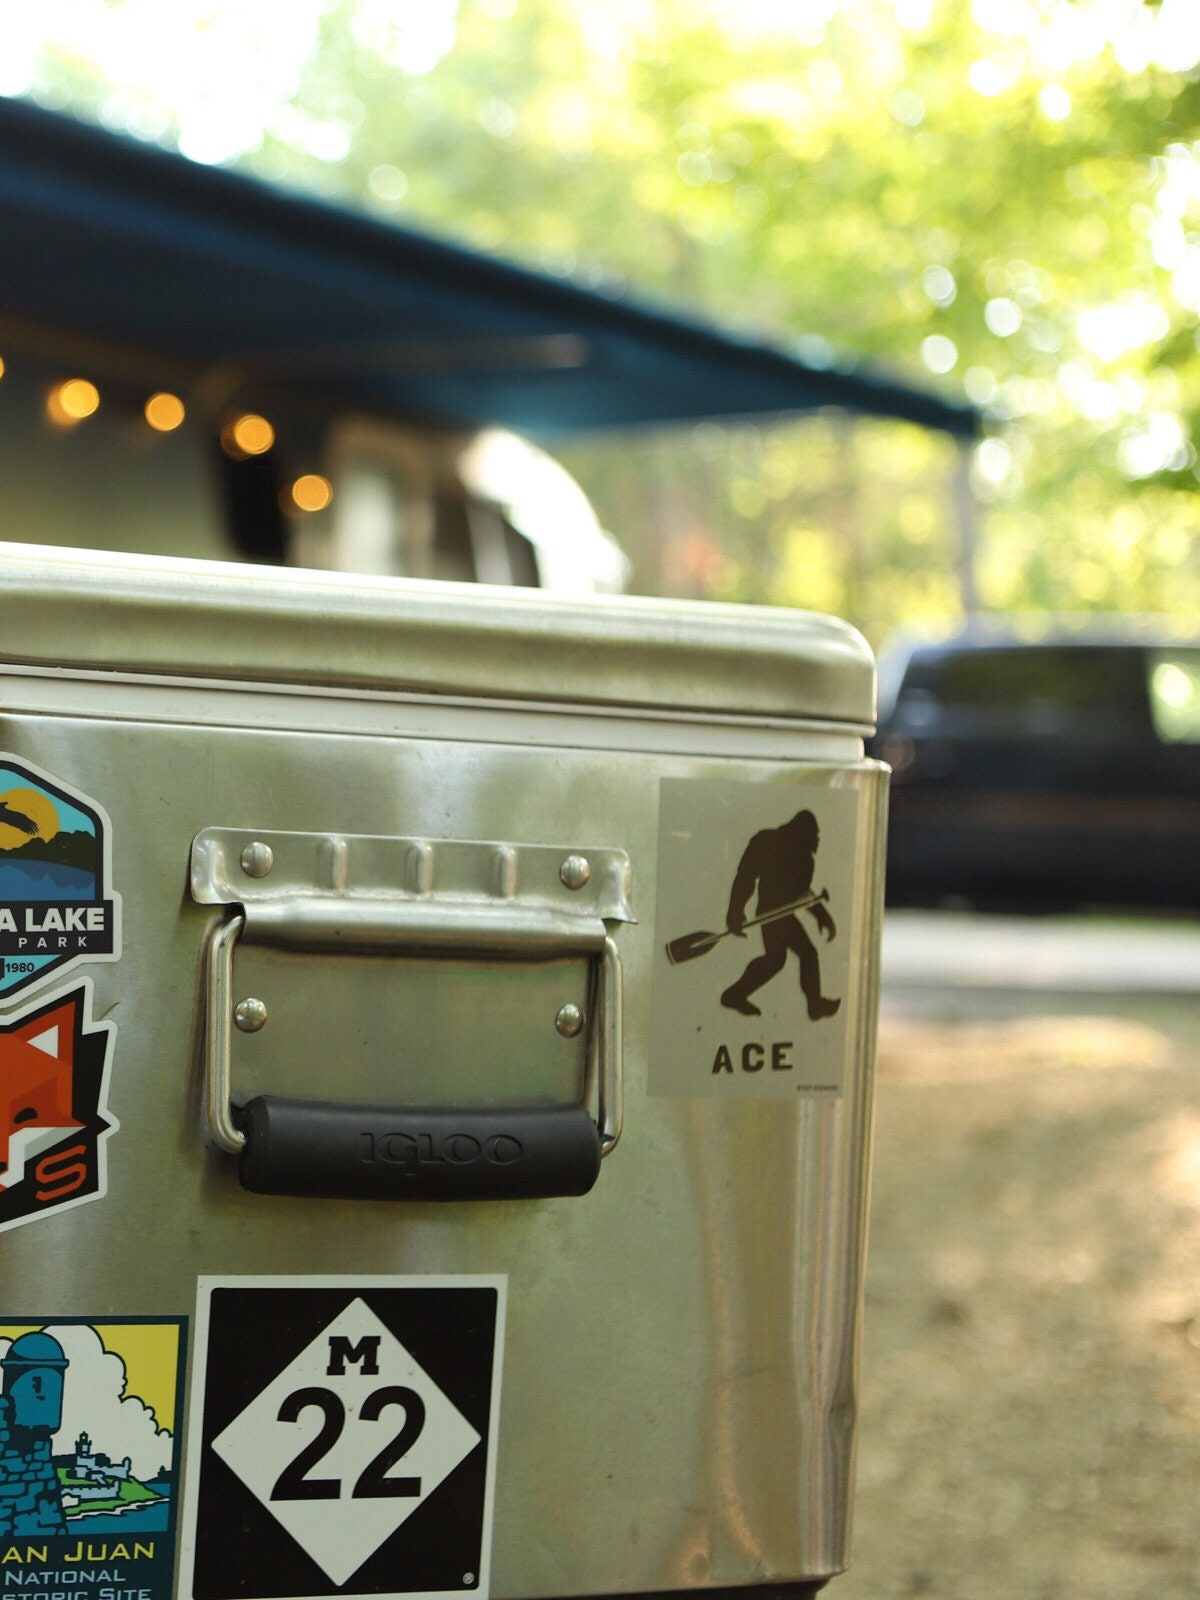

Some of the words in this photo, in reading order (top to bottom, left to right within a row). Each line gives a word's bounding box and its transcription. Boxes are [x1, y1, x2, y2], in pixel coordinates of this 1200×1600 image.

[25, 907, 105, 932] LAKE
[18, 936, 88, 949] PARK
[5, 962, 35, 973] 1980
[711, 1042, 794, 1074] ACE
[326, 1335, 381, 1376] M
[269, 1385, 426, 1502] 22
